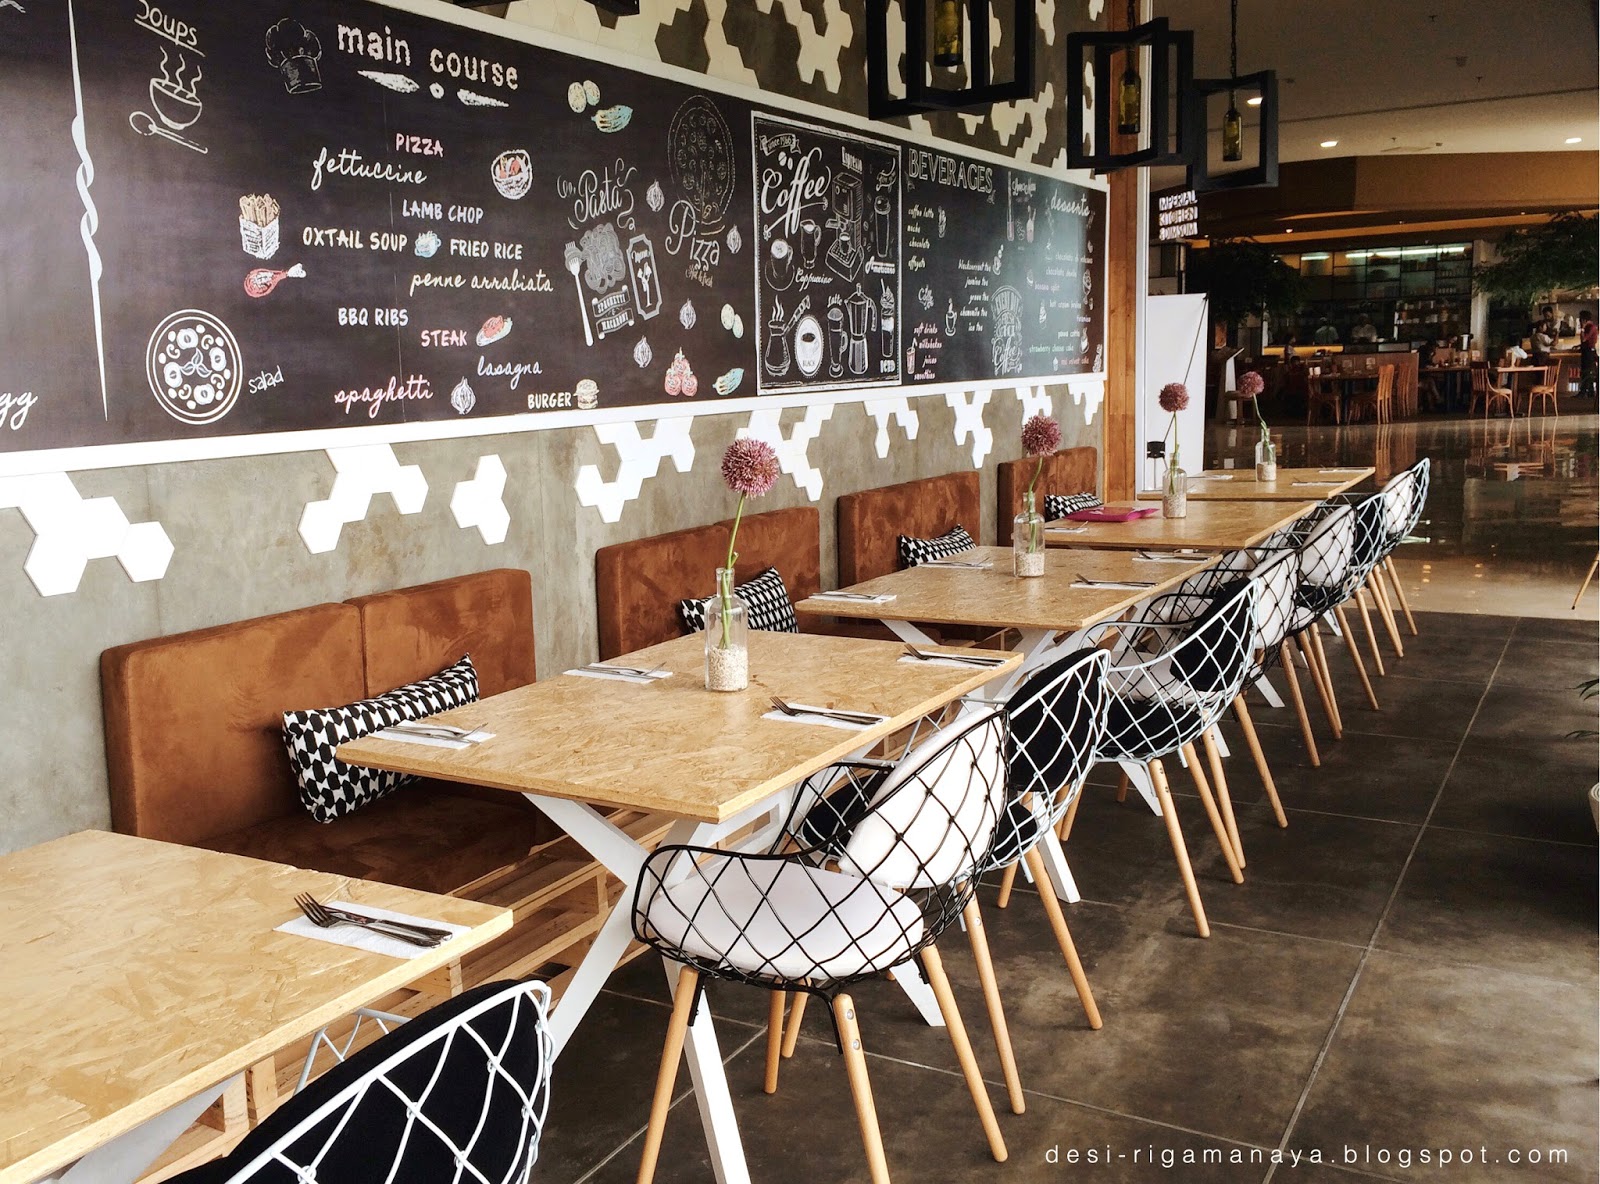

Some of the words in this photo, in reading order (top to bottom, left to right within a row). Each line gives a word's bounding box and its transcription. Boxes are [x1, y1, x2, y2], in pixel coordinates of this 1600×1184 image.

[337, 24, 411, 66] main
[429, 48, 519, 90] course
[395, 133, 444, 157] PIZZA
[311, 147, 427, 190] fettuccine
[908, 148, 994, 194] BEVERAGES
[574, 167, 623, 223] Pasta
[761, 147, 831, 238] Coffee
[1051, 188, 1090, 217] desserts
[403, 199, 443, 220] LAMB
[448, 204, 484, 225] CHOP
[303, 227, 363, 249] OXTAIL
[370, 232, 408, 252] SOUP
[450, 239, 489, 258] FRIED
[494, 243, 523, 260] RICE
[665, 200, 721, 272] Pizza
[410, 272, 466, 297] penne
[471, 268, 554, 292] arrabiata
[338, 308, 368, 326] BBQ
[375, 308, 408, 326] RIBS
[421, 329, 468, 347] STEAK
[248, 365, 284, 394] salad
[477, 356, 542, 390] lasagna
[334, 374, 434, 418] spaghetti
[527, 392, 572, 410] BURGER
